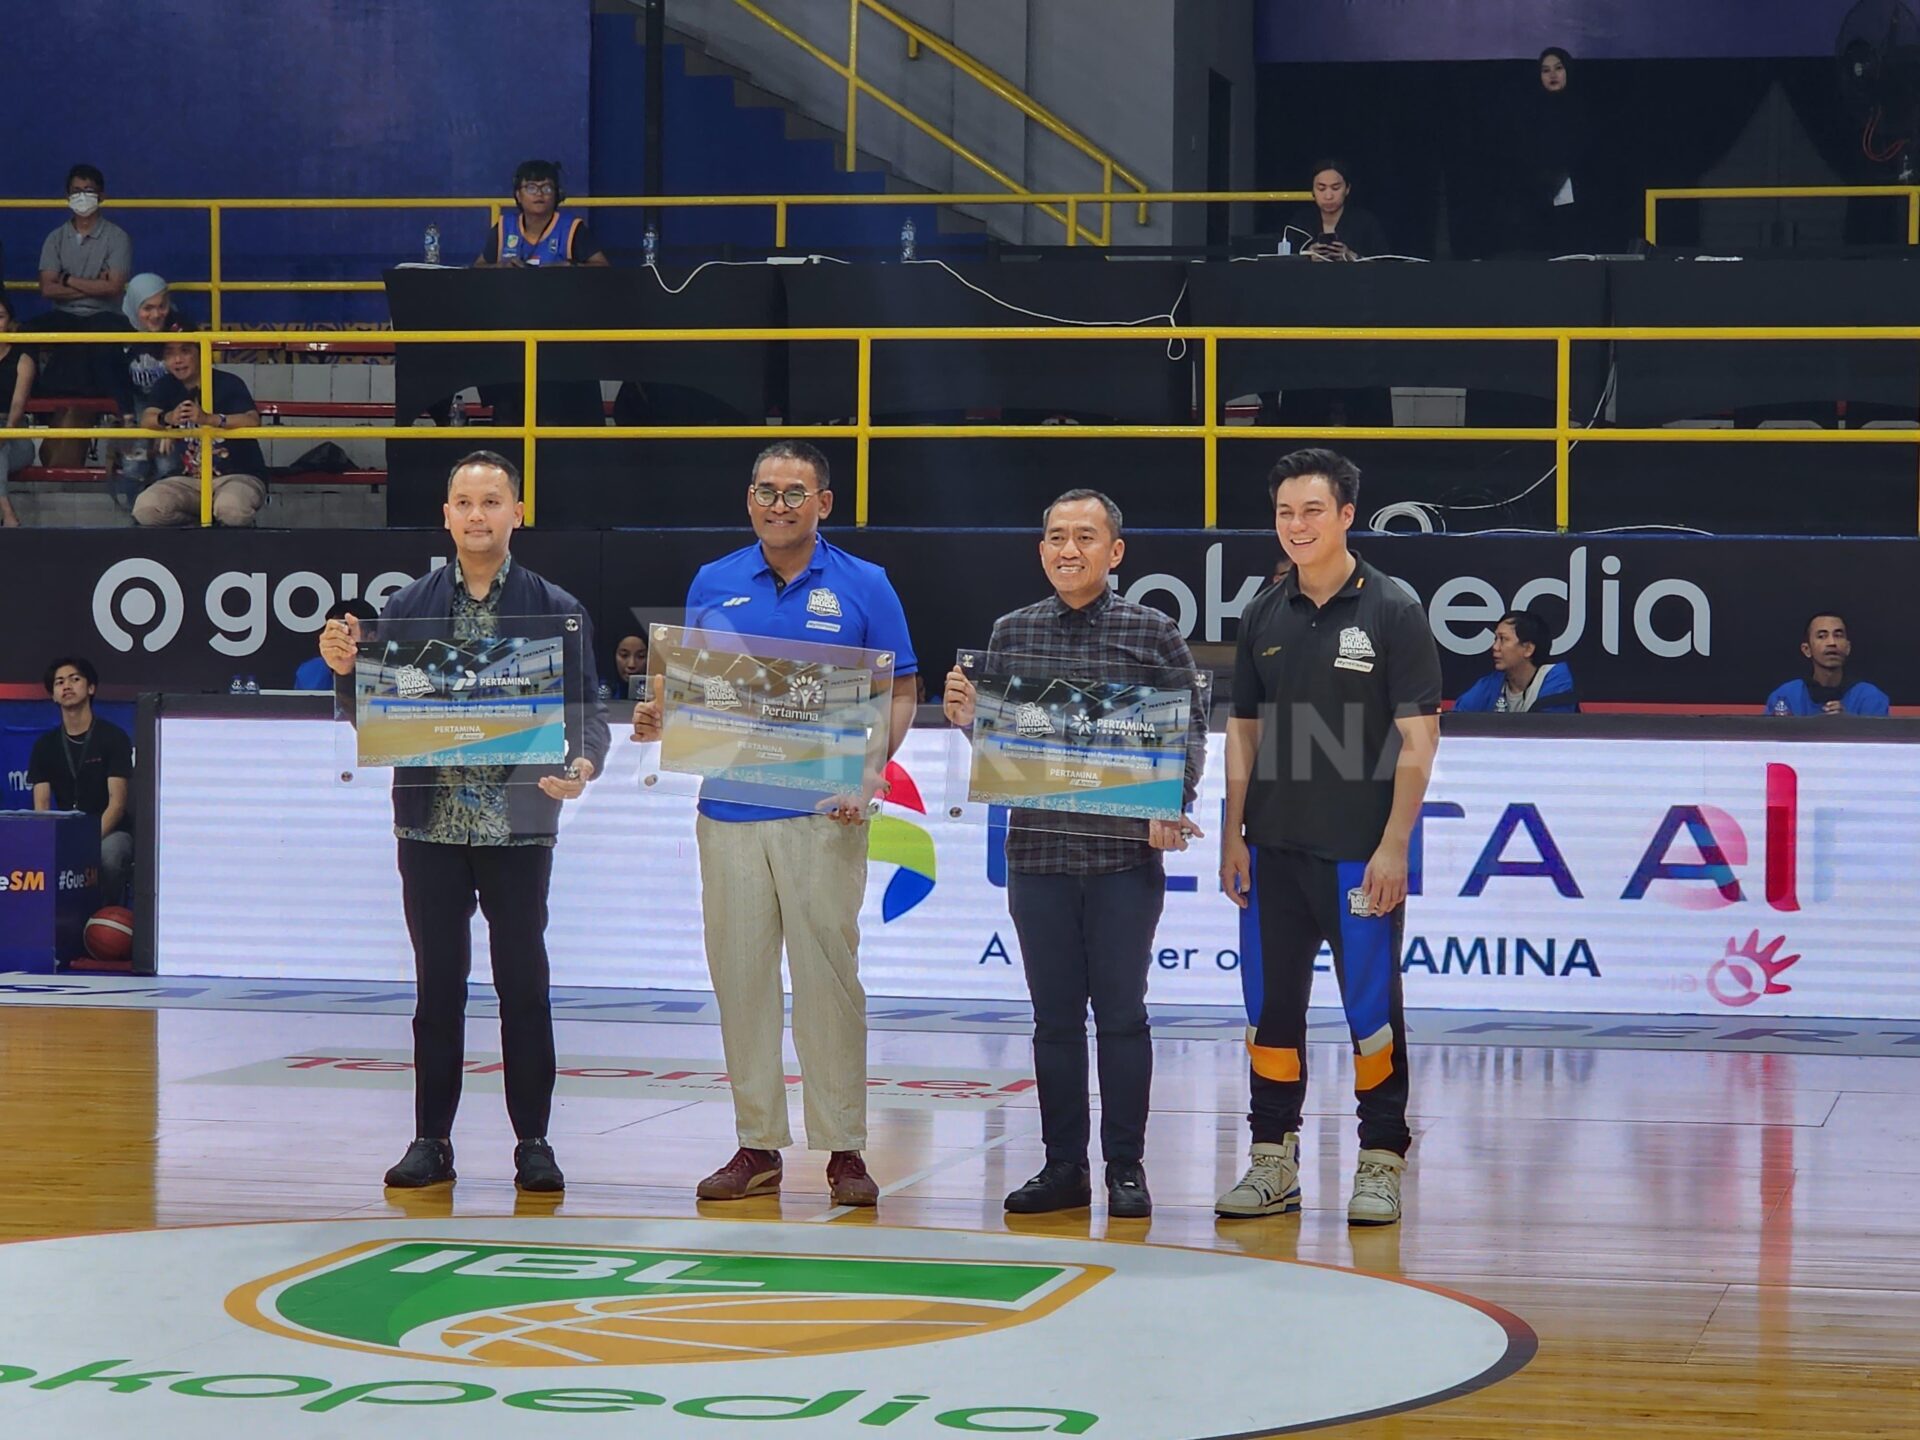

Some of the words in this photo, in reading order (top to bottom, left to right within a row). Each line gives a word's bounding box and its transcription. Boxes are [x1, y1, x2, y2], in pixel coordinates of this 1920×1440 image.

[480, 677, 531, 687] PERTAMINA
[762, 704, 819, 722] Pertamina
[434, 725, 481, 734] PERTAMINA
[1097, 718, 1155, 732] PERTAMINA
[737, 741, 784, 753] PERTAMINA
[1050, 768, 1098, 780] PERTAMINA
[979, 931, 1012, 966] A
[391, 1250, 764, 1287] IBL
[0, 1359, 1100, 1434] kopedia
